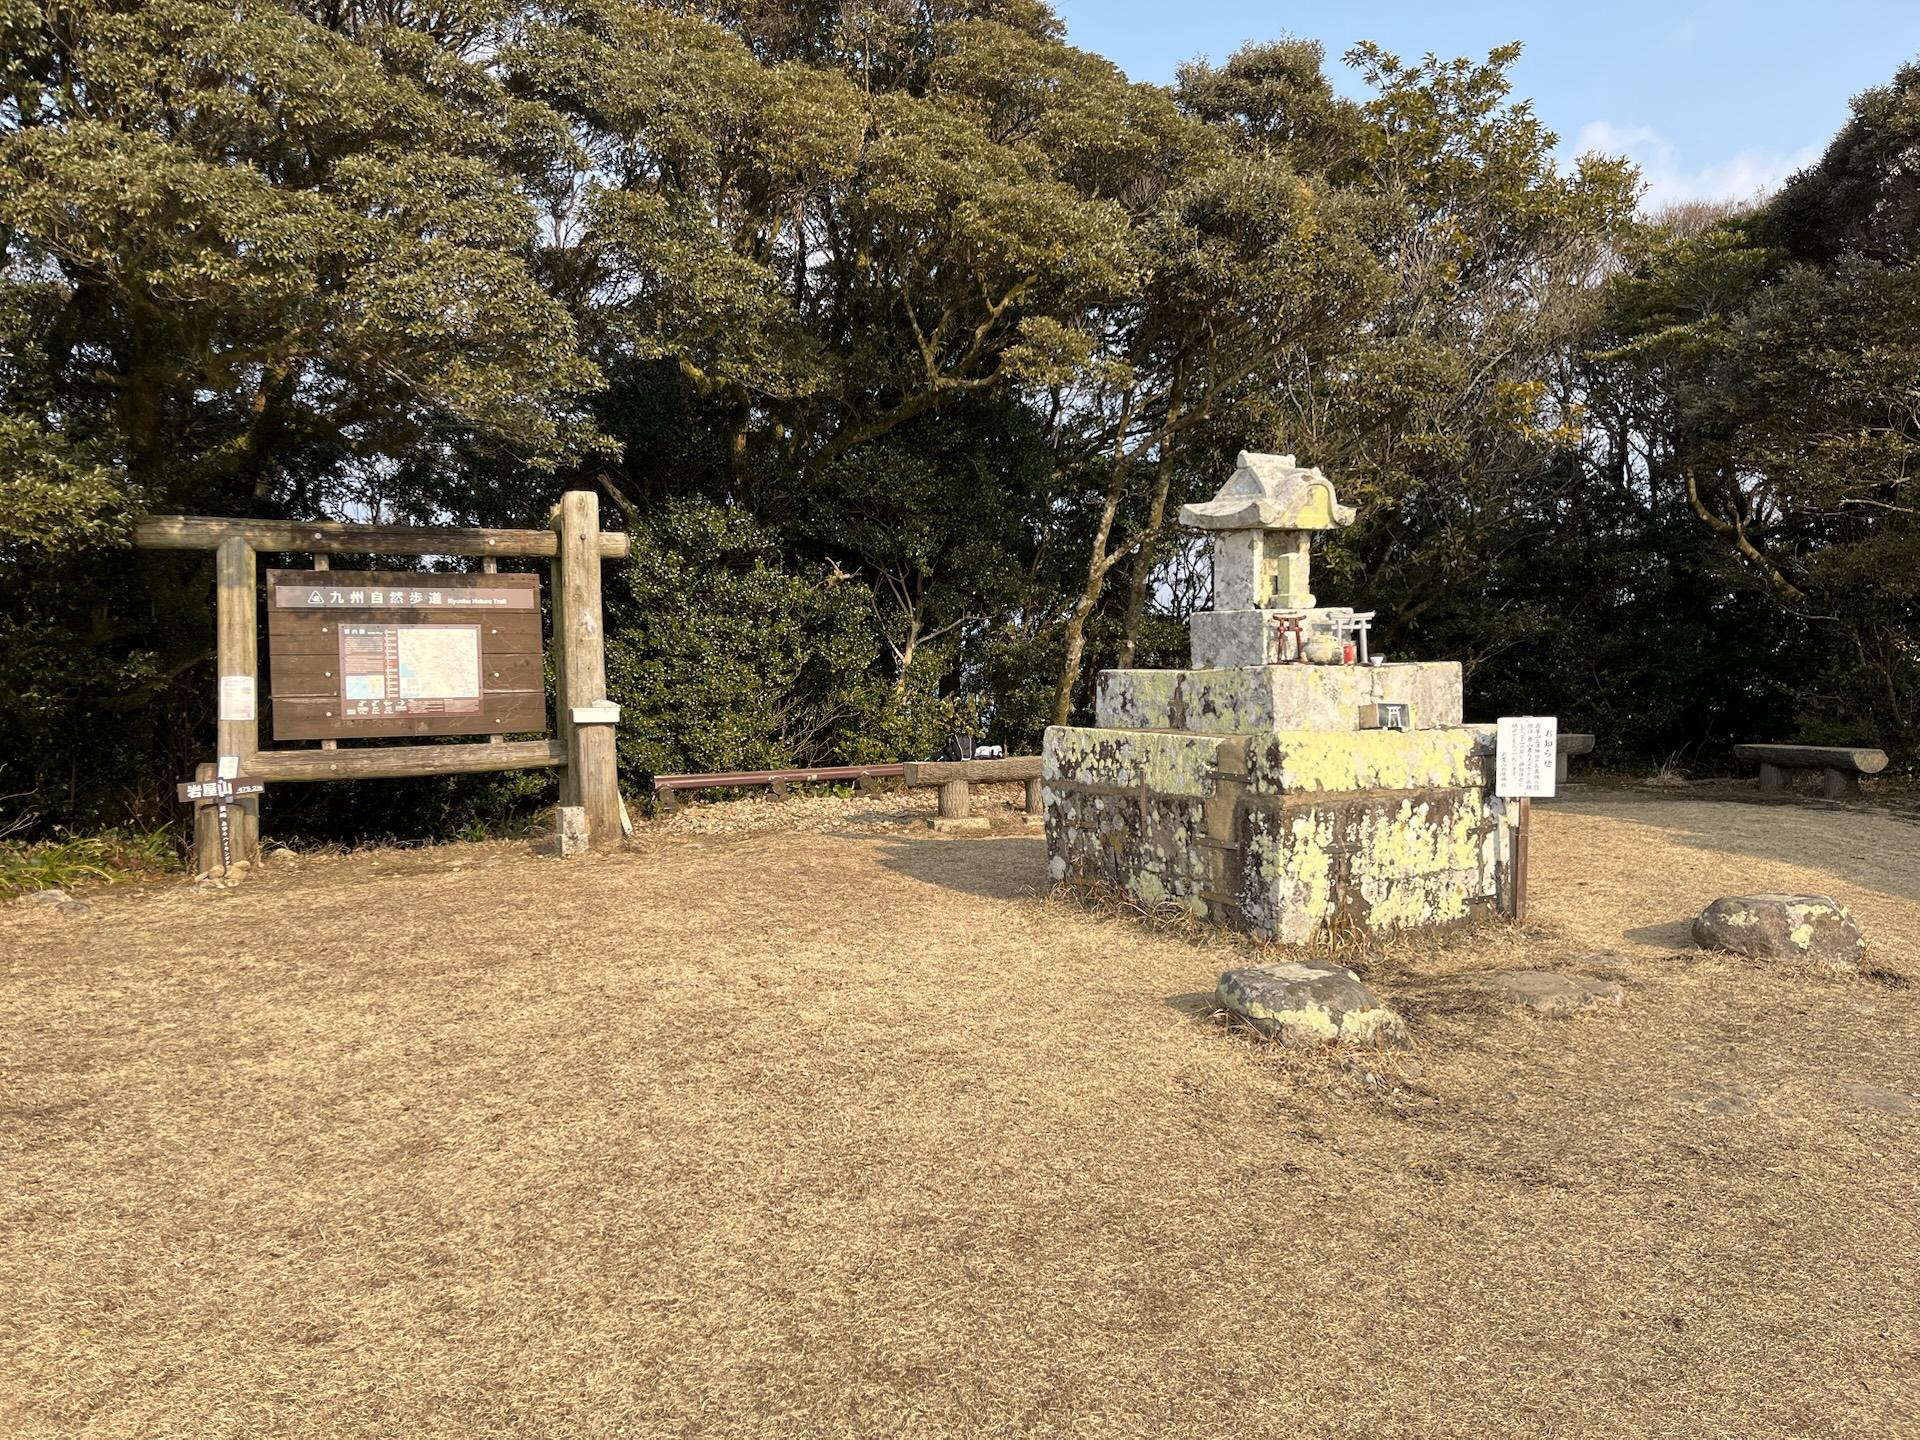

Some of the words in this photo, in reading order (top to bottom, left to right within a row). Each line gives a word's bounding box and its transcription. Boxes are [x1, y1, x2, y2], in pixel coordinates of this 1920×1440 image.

[329, 590, 442, 605] 九州自然歩道
[1544, 729, 1553, 768] お知らせ
[187, 780, 233, 798] 岩屋山
